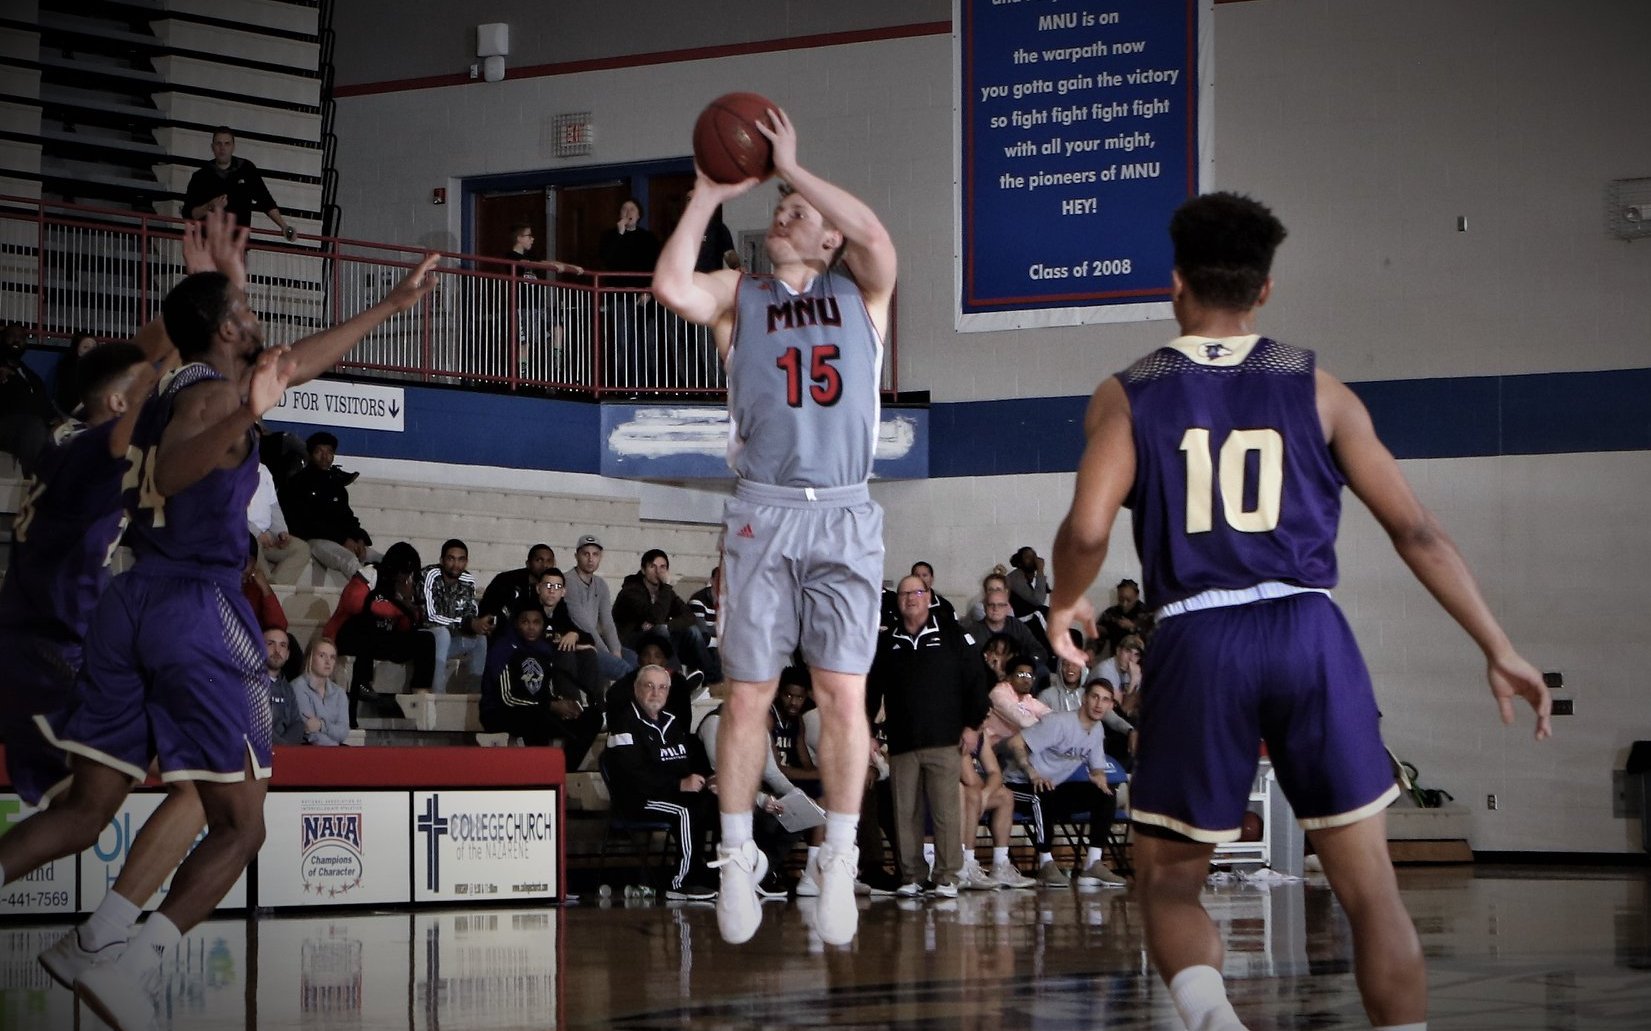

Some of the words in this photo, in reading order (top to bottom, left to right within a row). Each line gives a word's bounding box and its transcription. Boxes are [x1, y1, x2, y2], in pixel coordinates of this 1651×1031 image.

[1038, 12, 1077, 31] MNU
[1082, 11, 1095, 26] is
[1099, 12, 1119, 25] on
[1013, 48, 1038, 64] the
[1043, 41, 1108, 63] warpath
[1112, 41, 1146, 55] now
[981, 85, 1008, 102] you
[1013, 79, 1053, 99] gotta
[1058, 74, 1093, 95] gain
[1097, 71, 1122, 87] the
[1127, 67, 1179, 85] victory
[990, 116, 1008, 129] so
[1012, 109, 1047, 129] fight
[1051, 106, 1088, 126] fight
[1092, 103, 1129, 123] fight
[1132, 98, 1170, 118] fight
[1004, 141, 1037, 158] with
[1041, 138, 1061, 155] all
[1065, 139, 1101, 157] your
[1104, 132, 1155, 150] might,
[1000, 172, 1025, 189] the
[1029, 169, 1096, 191] pioneers
[1100, 165, 1117, 181] of
[1120, 162, 1161, 180] MNU
[1062, 198, 1097, 216] HEY!
[1029, 263, 1068, 280] Class
[1073, 261, 1089, 277] of
[1093, 259, 1132, 276] 2008
[767, 297, 842, 334] MNU
[776, 344, 842, 407] 15
[293, 391, 320, 411] FOR
[325, 394, 385, 417] VISITORS
[1179, 428, 1284, 534] 10
[303, 816, 360, 849] NAIA
[451, 813, 504, 841] COLLEGE
[506, 812, 552, 841] CHURCH
[308, 868, 316, 876] of
[318, 867, 355, 877] Character
[311, 855, 352, 865] Champions
